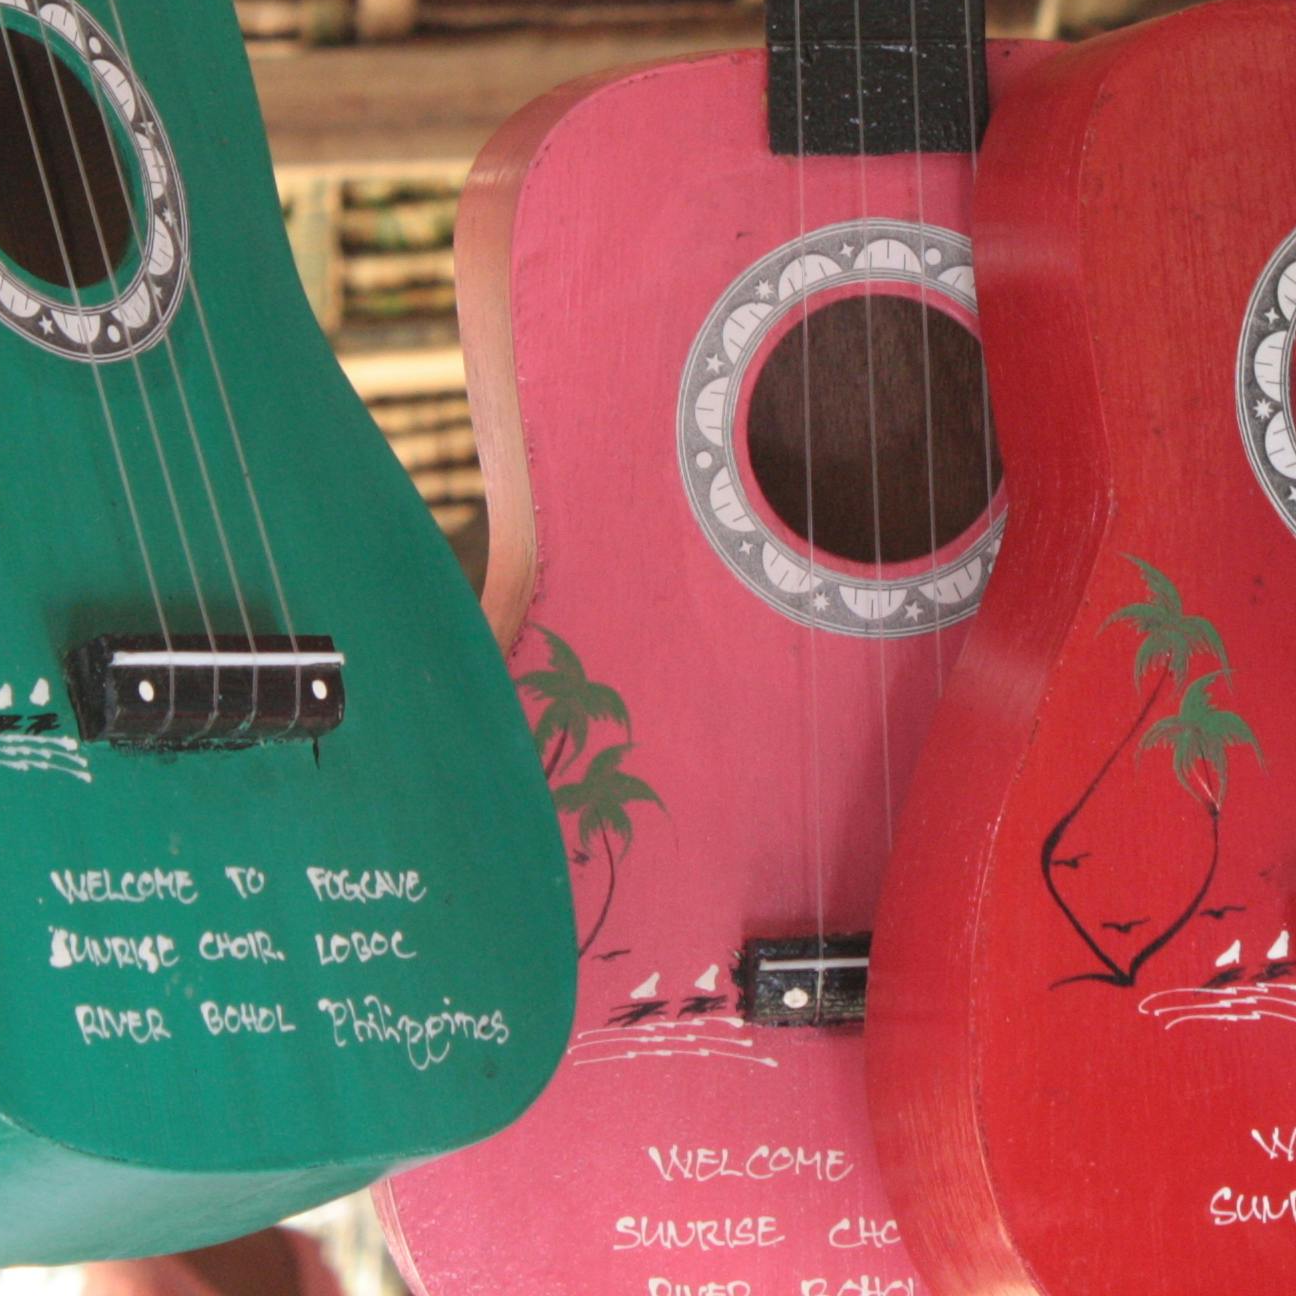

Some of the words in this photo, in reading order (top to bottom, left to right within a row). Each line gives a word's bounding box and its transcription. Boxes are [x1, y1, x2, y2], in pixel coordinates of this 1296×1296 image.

[50, 866, 198, 905] WELCOME
[225, 866, 264, 899] TO
[306, 866, 427, 904] FOGCAVE
[48, 925, 179, 974] SUNRISE
[314, 931, 416, 966] LOBOC
[75, 1003, 172, 1045] RIVER
[200, 1001, 296, 1034] BOHOL
[317, 995, 509, 1071] Philippines
[648, 1145, 854, 1181] WELCOME
[613, 1217, 785, 1251] SUNRISE
